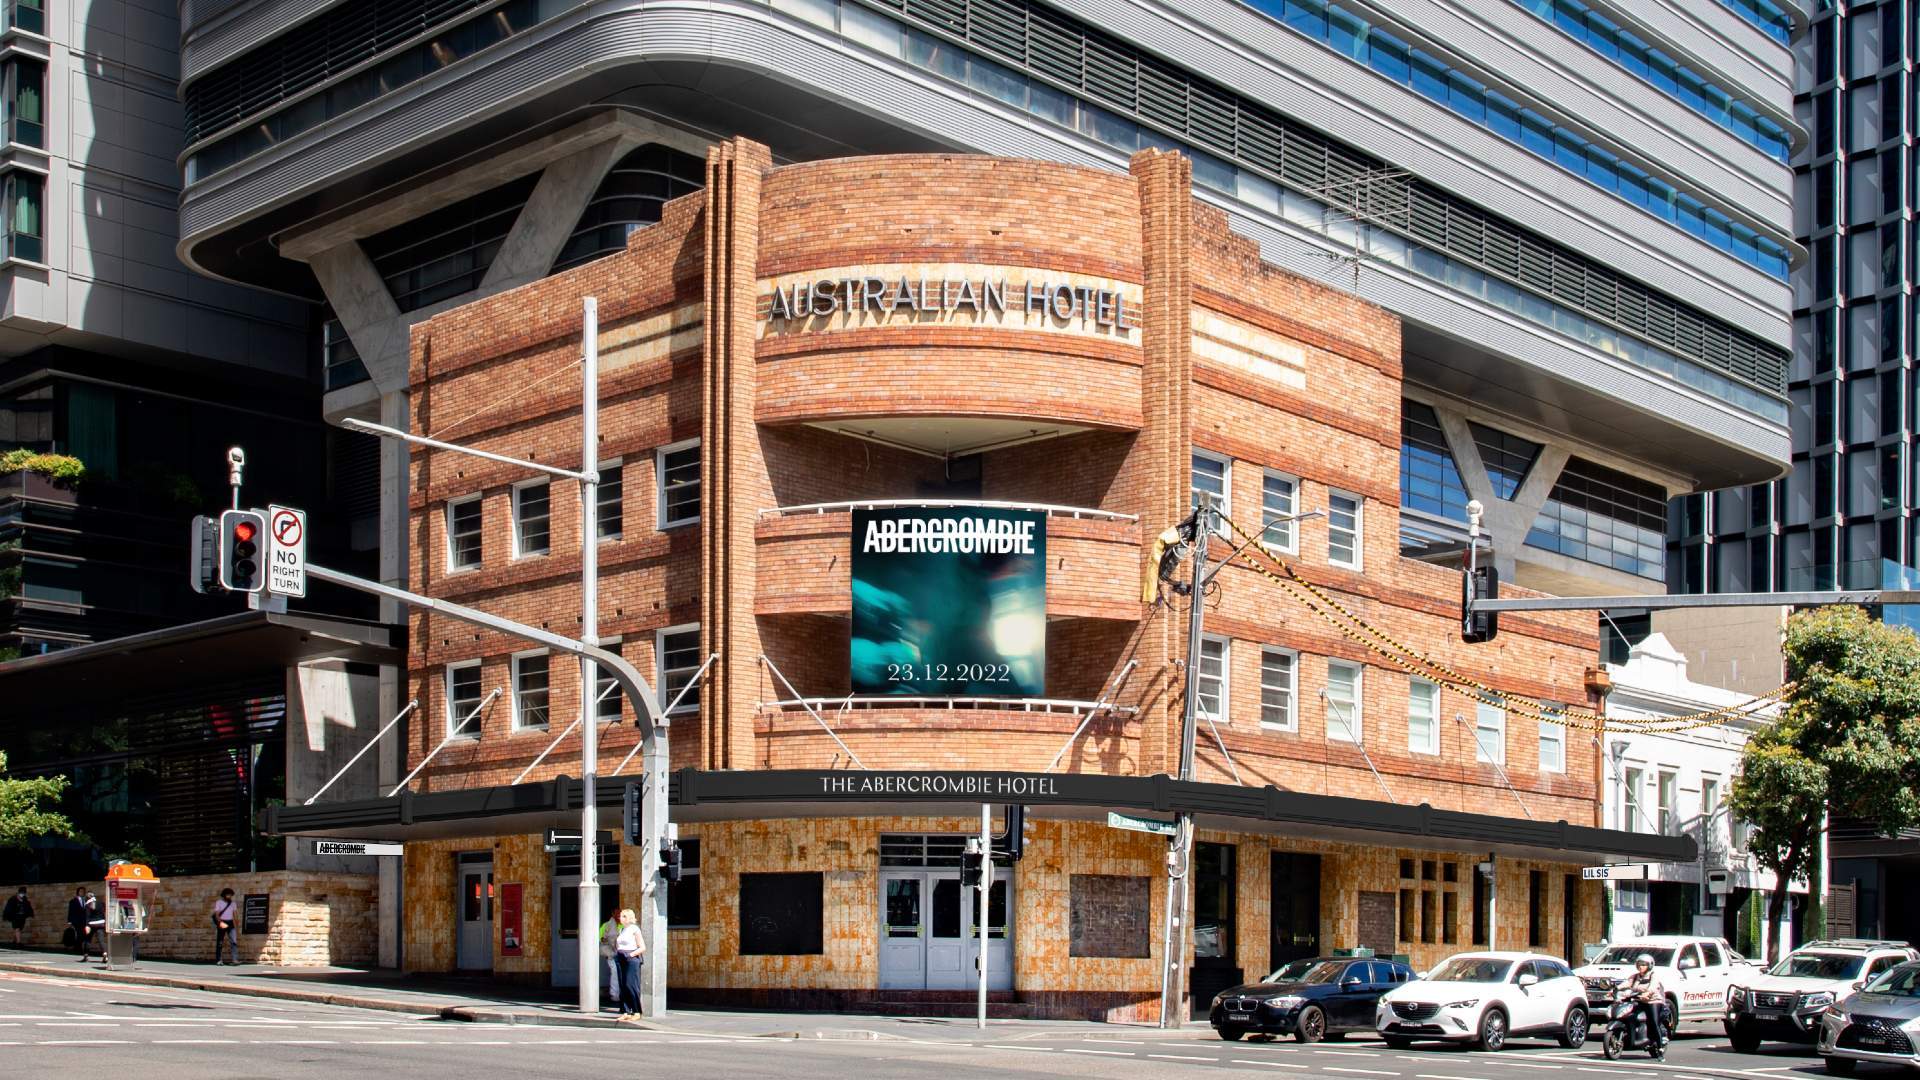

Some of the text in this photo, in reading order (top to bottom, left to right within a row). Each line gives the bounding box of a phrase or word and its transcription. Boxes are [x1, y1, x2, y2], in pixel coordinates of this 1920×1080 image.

[768, 276, 1134, 330] AUSTRALIAN HOTEL
[863, 517, 1036, 554] ABERCROMBIE
[277, 550, 297, 565] NO
[272, 565, 300, 578] RIGHT
[274, 577, 300, 590] TURN
[887, 663, 1011, 683] 23.12.2022
[820, 775, 1059, 795] THE ABERCROMBIE HOTEL
[319, 842, 366, 854] ABERCROMBIE
[1583, 868, 1610, 878] LIL SIS
